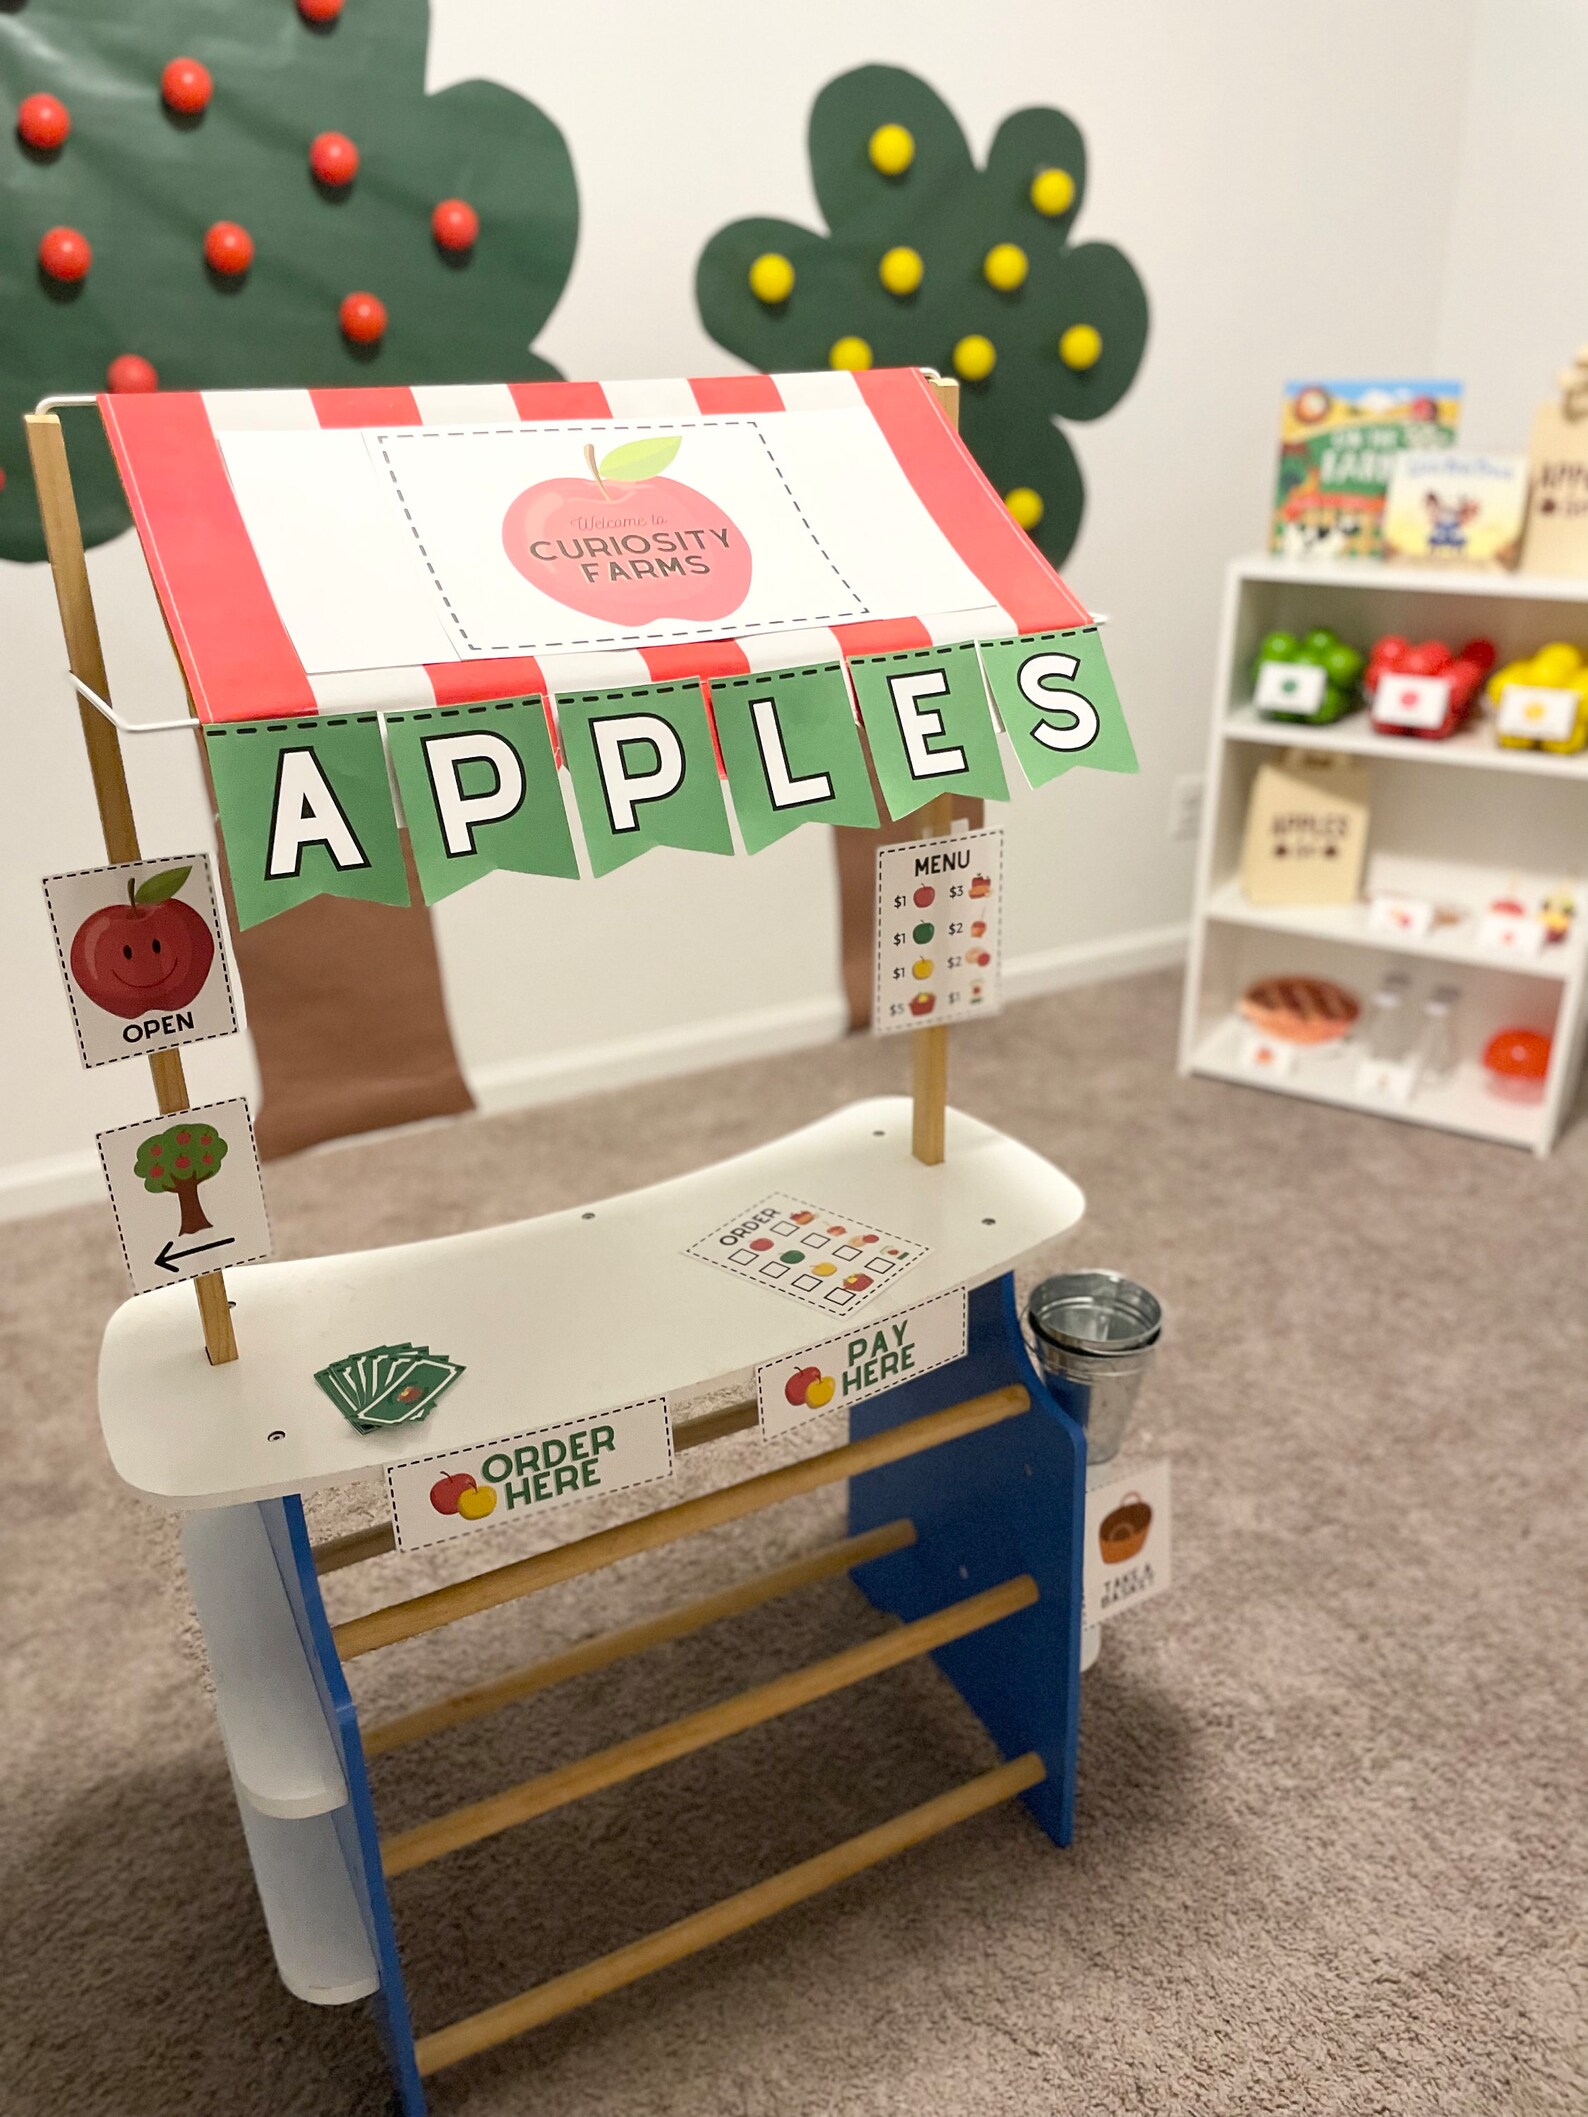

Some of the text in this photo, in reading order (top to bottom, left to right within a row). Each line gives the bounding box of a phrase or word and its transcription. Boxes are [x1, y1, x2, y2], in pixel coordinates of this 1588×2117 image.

[571, 514, 668, 532] Welcome to
[529, 527, 731, 562] CURIOSITY
[580, 555, 712, 584] FARMS
[263, 652, 1101, 882] APPLES
[914, 849, 971, 877] MENU
[893, 895, 907, 909] $1
[949, 885, 964, 898] $3
[893, 932, 906, 946] $1
[948, 922, 964, 935] $2
[892, 967, 906, 980] $1
[947, 956, 963, 969] $2
[122, 1010, 195, 1043] OPEN
[719, 1207, 782, 1246] ORDER
[847, 1319, 909, 1367] PAY
[841, 1342, 916, 1397] HERE
[480, 1424, 616, 1483] ORDER
[504, 1457, 602, 1510] HERE
